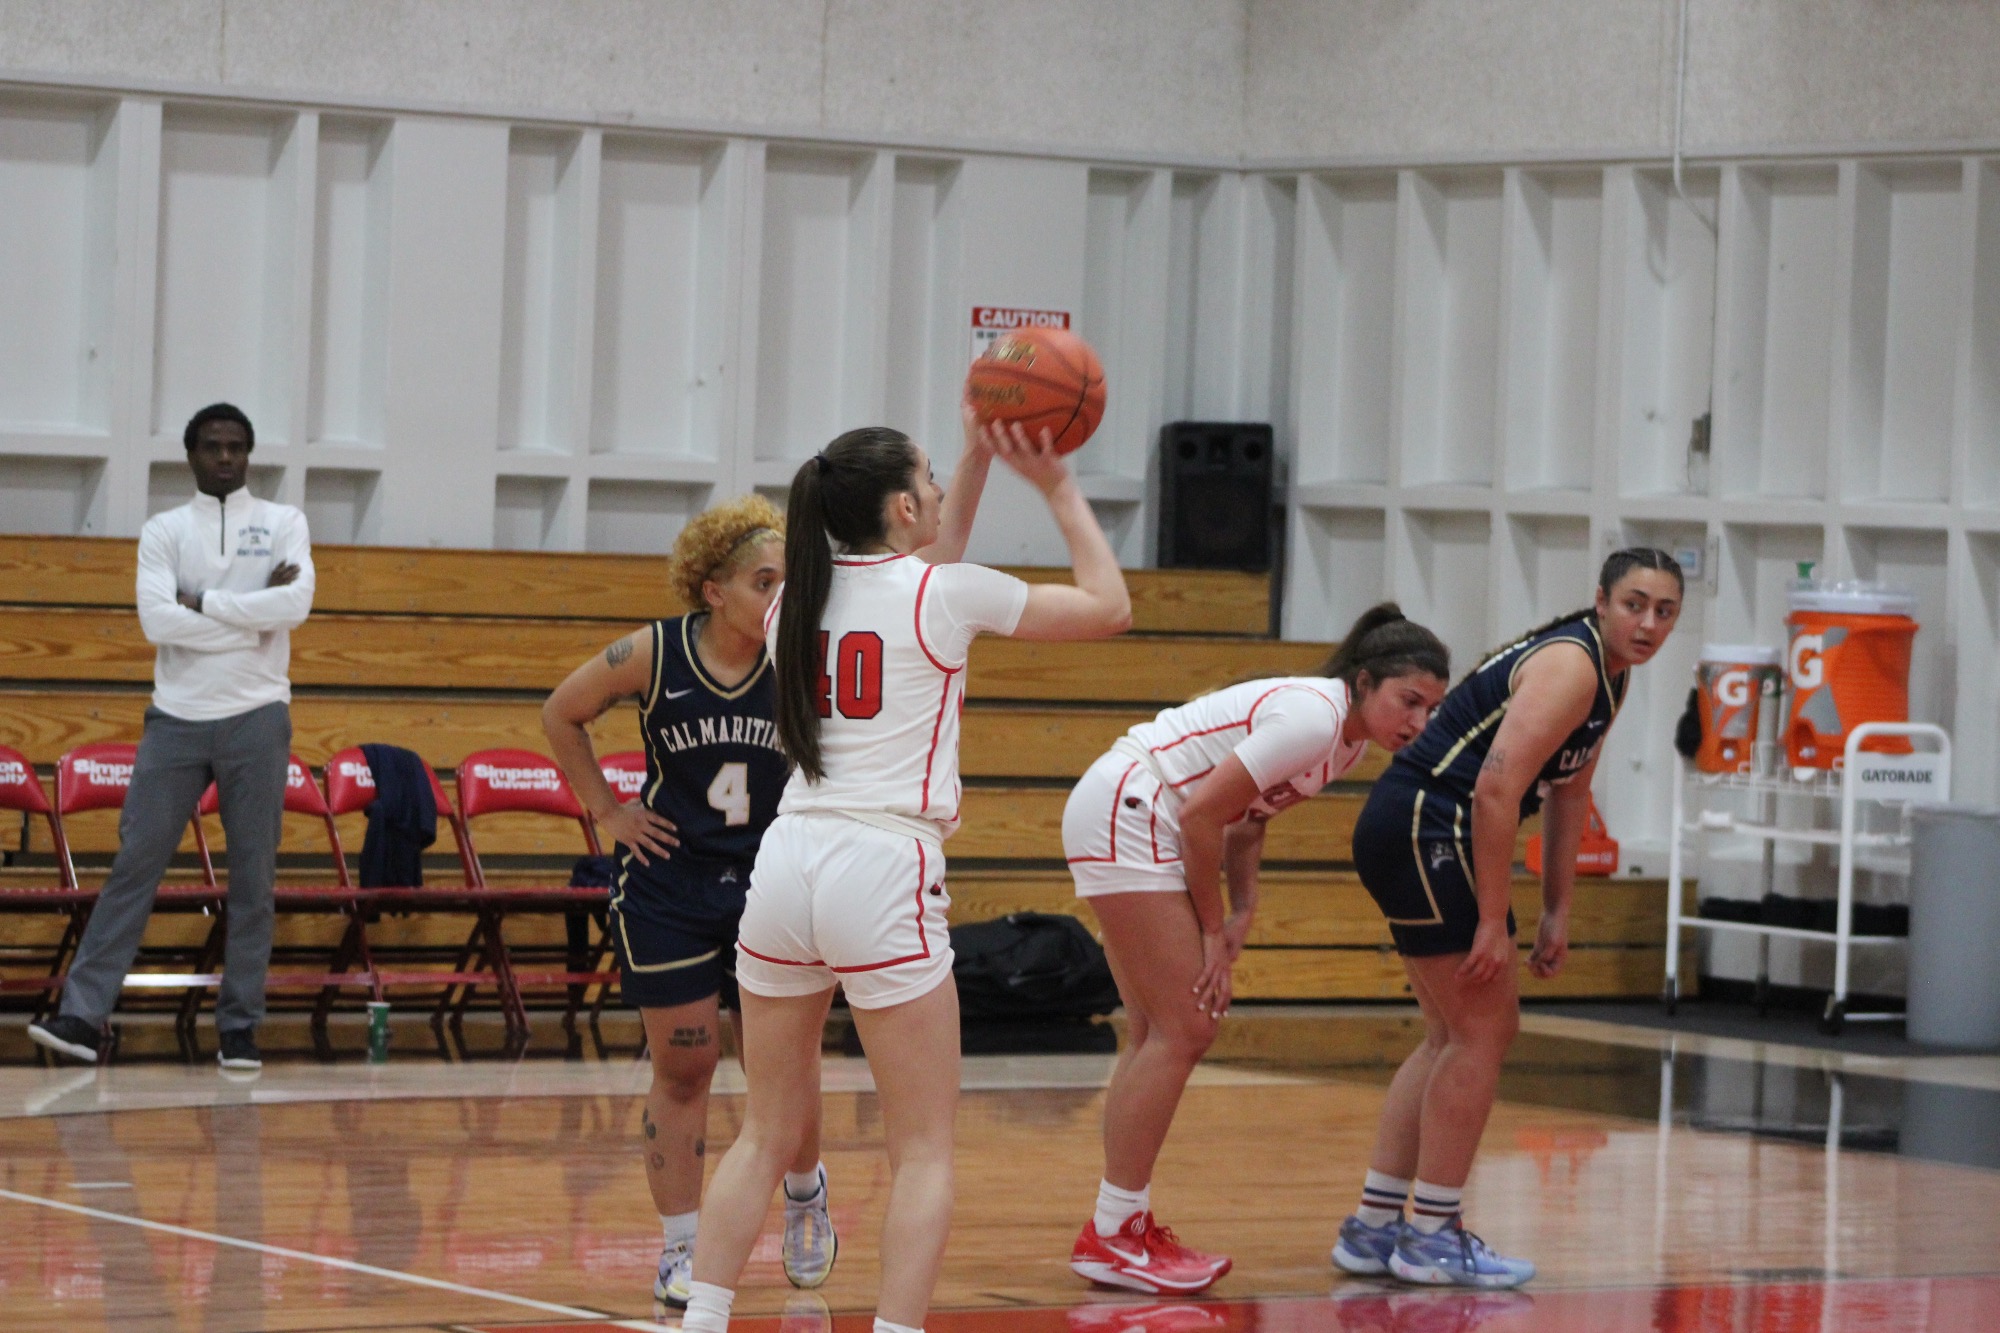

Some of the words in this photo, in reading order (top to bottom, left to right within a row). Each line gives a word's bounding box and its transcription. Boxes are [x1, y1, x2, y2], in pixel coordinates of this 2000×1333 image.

[980, 309, 1064, 329] CAUTION
[1790, 634, 1823, 688] G
[1717, 670, 1748, 706] G
[660, 722, 698, 753] CAL
[698, 715, 786, 756] MARITI
[473, 764, 557, 780] Simpson
[1861, 769, 1933, 784] GATORADE
[707, 762, 750, 826] 4
